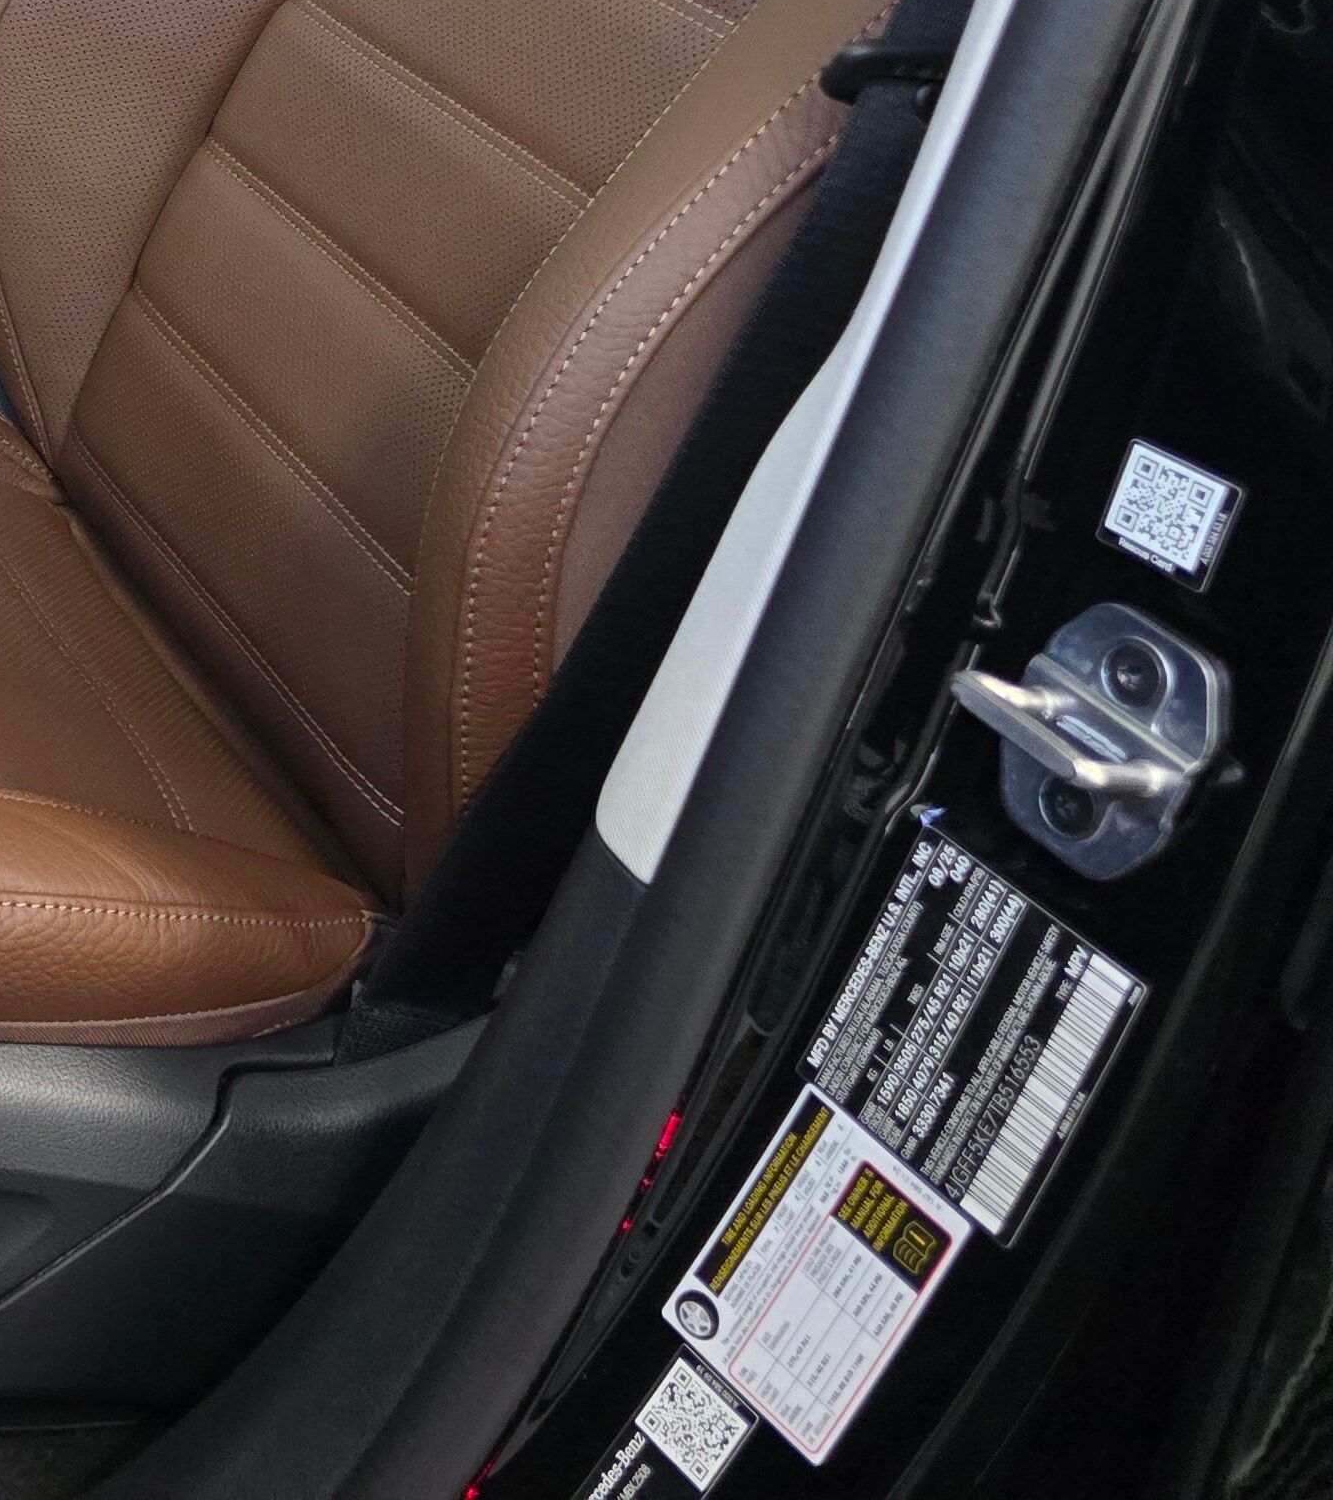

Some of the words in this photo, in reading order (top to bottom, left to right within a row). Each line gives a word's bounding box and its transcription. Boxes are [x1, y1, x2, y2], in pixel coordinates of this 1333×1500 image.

[910, 838, 934, 869] INC
[925, 842, 960, 891] 08/25
[947, 851, 972, 884] 040
[880, 897, 904, 929] U.S.
[1038, 922, 1061, 954] SAFETY
[830, 922, 891, 1024] MERCEDES-BENZ
[1024, 948, 1047, 982] VEHICLE
[1062, 943, 1090, 979] MPV
[865, 1065, 878, 1082] KG
[881, 1036, 894, 1052] LB
[906, 981, 924, 1006] TIRES
[951, 894, 969, 918] COLD
[874, 1070, 901, 1108] 1590
[891, 1039, 918, 1077] 3505
[908, 994, 944, 1046] 275/45
[932, 971, 954, 1000] R21
[968, 876, 1006, 931] 280(41)
[1011, 976, 1032, 1007] MOTOR
[1022, 980, 1045, 1012] SHOWN
[816, 1030, 853, 1090] MANUFACTURED
[876, 929, 907, 978] TUSCALOOSA
[893, 1085, 919, 1123] 1850
[909, 1054, 937, 1092] 4079
[927, 1008, 962, 1061] 315/40
[950, 985, 973, 1015] R21
[986, 890, 1025, 946] 300(44)
[820, 1016, 841, 1042] BY
[995, 1006, 1030, 1062] MANUFACTURE
[805, 1033, 831, 1069] MFD
[826, 1068, 845, 1097] UNDER
[838, 1034, 863, 1074] CONTRACT
[857, 1019, 872, 1038] FOR
[835, 1063, 861, 1105] STUTTGART
[854, 1025, 883, 1070] (GERMANY)
[975, 1030, 1004, 1074] APPLICABLE
[990, 1056, 1003, 1072] OF
[963, 1081, 976, 1097] TO
[968, 1070, 982, 1087] ALL
[974, 1083, 989, 1102] THE
[981, 1066, 999, 1089] DATE
[867, 1105, 886, 1132] FRONT
[910, 1100, 938, 1139] 3330
[928, 1069, 955, 1107] 7341
[941, 1031, 1044, 1203] 4JGFF5KE7TB516553
[942, 1091, 971, 1135] CONFORMS
[968, 1097, 982, 1114] ON
[793, 1105, 831, 1158] CHARGEMENT
[885, 1124, 902, 1148] REAR
[955, 1109, 975, 1138] EFFECT
[787, 1152, 801, 1168] LE
[927, 1129, 950, 1162] VEHICLE
[782, 1162, 794, 1177] ET
[919, 1155, 936, 1177] THIS
[929, 1141, 958, 1185] STANDARDS
[720, 1225, 737, 1247] TIRE
[731, 1210, 747, 1231] AND
[740, 1179, 767, 1215] LOADING
[760, 1130, 798, 1184] INFORMATION
[766, 1171, 789, 1201] PNEUS
[748, 1209, 765, 1231] SUR
[758, 1196, 773, 1215] LES
[836, 1201, 852, 1221] SEE
[848, 1194, 875, 1230] MANUAL
[867, 1178, 885, 1199] FOR
[860, 1190, 896, 1239] ADDITIONAL
[870, 1197, 909, 1253] INFORMATION
[708, 1224, 754, 1292] RENSEIGNEMENTS
